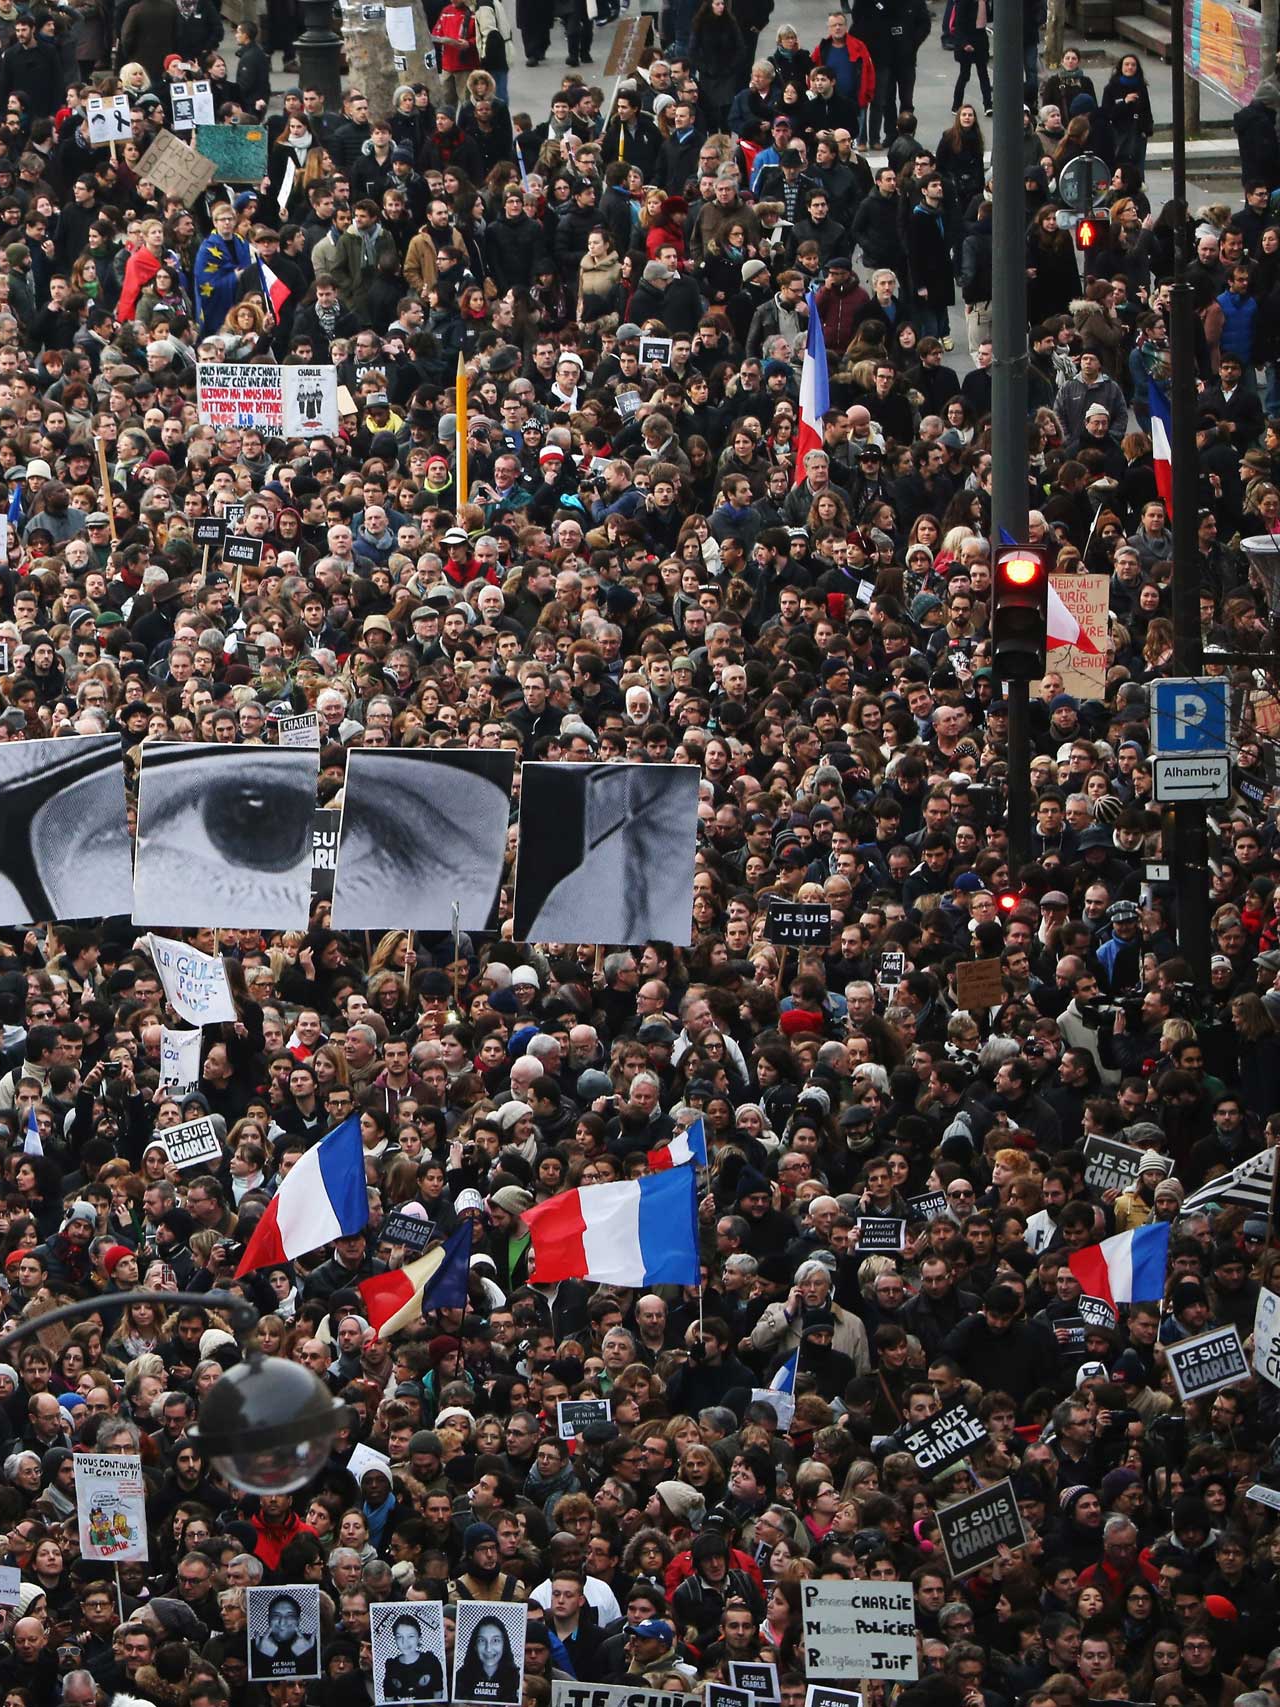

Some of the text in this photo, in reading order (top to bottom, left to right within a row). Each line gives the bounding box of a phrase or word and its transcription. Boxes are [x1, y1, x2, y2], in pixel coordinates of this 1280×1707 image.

[229, 550, 253, 560] CHARLIE
[283, 715, 315, 730] CHARLIE
[1176, 696, 1209, 739] P
[1163, 766, 1221, 777] Alhambra
[1156, 867, 1160, 878] 1
[773, 913, 829, 923] JE SUIS
[780, 927, 822, 937] JUIF
[166, 1122, 210, 1146] JE SUIS
[169, 1134, 217, 1163] CHARLIE
[1089, 1151, 1142, 1177] JE SU
[1084, 1165, 1135, 1193] CHAR
[919, 1195, 946, 1210] SUIS
[389, 1218, 431, 1235] JE SUIS
[385, 1225, 428, 1245] CHARLIE
[1080, 1300, 1093, 1311] JE
[1178, 1351, 1199, 1369] JE
[1199, 1337, 1237, 1361] SUIS
[1182, 1351, 1245, 1388] CHARLIE
[903, 1403, 969, 1452] JE SUIS
[914, 1417, 987, 1468] CHARLIE
[76, 1457, 99, 1468] NOUS
[949, 1498, 1010, 1538] JE SUIS
[951, 1513, 1017, 1561] CHARLIE
[272, 1667, 297, 1675] CHARLIE
[750, 1674, 766, 1682] SUIS
[474, 1688, 497, 1696] CHARLIE
[741, 1680, 768, 1689] CHARLIE
